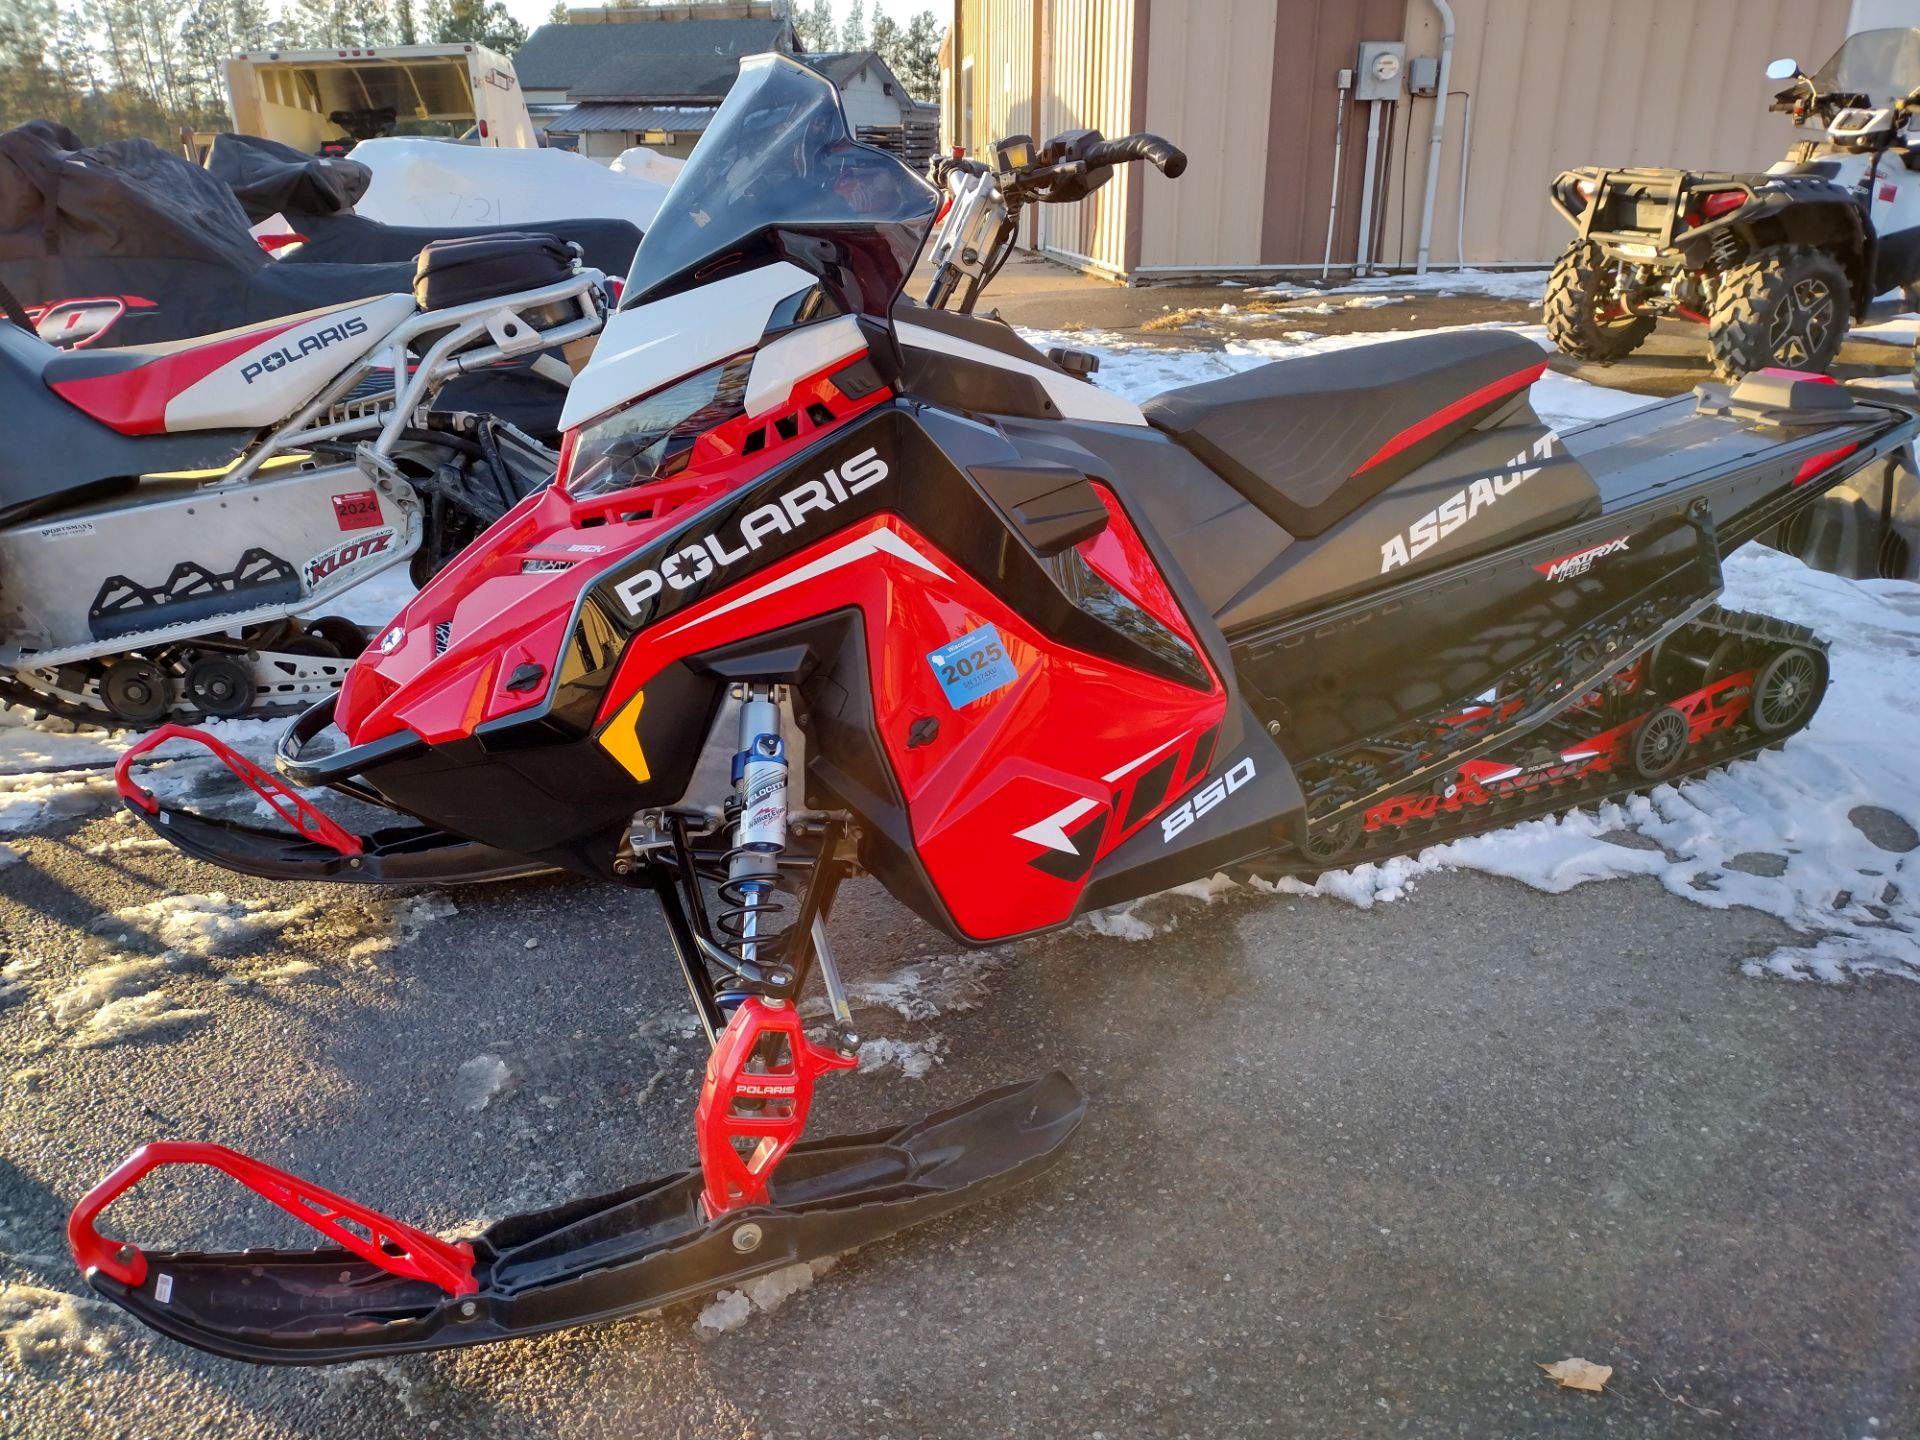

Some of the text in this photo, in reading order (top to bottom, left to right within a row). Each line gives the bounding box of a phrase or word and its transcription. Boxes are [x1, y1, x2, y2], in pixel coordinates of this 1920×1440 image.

[240, 316, 368, 384] POLARIS
[338, 502, 377, 516] 2024
[1380, 429, 1560, 574] ASSAULT
[614, 446, 889, 616] POLARIS
[312, 533, 395, 586] KLOTZ
[1546, 535, 1630, 582] MATRYX
[941, 642, 1003, 687] 2025
[1160, 756, 1257, 844] 850
[736, 1085, 796, 1095] POLARIS
